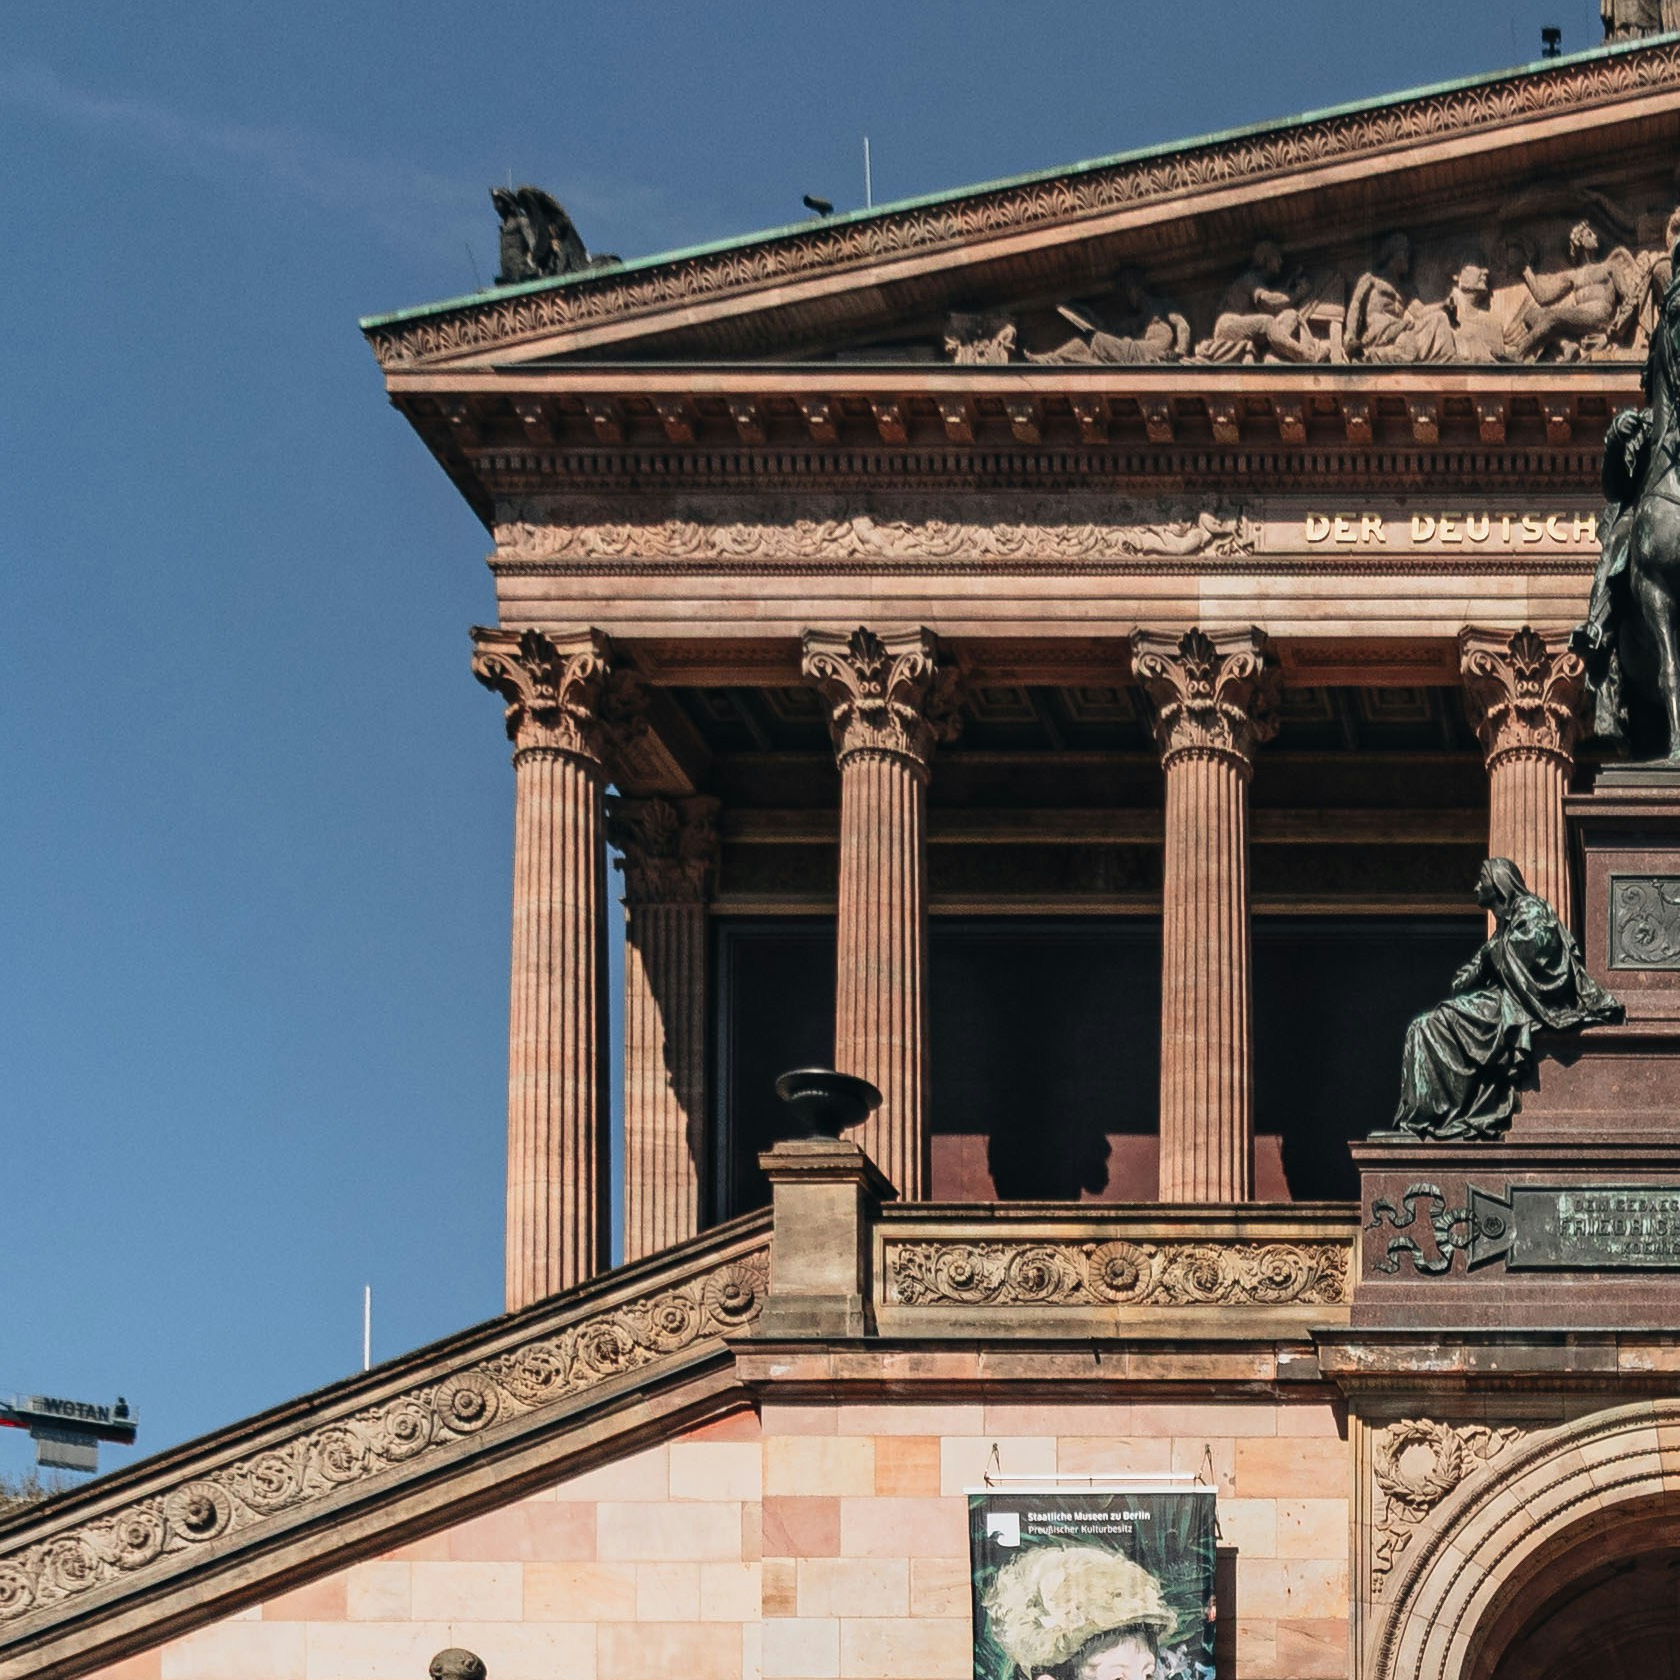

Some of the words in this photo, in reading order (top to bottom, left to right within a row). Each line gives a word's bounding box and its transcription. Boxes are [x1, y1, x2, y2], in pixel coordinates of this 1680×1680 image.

[1305, 511, 1386, 543] DER
[1411, 511, 1597, 543] DEUTSCH
[1573, 1199, 1610, 1213] DEM
[43, 1397, 110, 1422] WOTAN
[1027, 1512, 1073, 1522] Staatliche
[1073, 1511, 1106, 1522] Museen
[1110, 1513, 1121, 1521] zu
[1123, 1510, 1151, 1521] Berlin
[1028, 1525, 1079, 1535] Preußischer
[1081, 1523, 1133, 1534] Kulturbesitz
